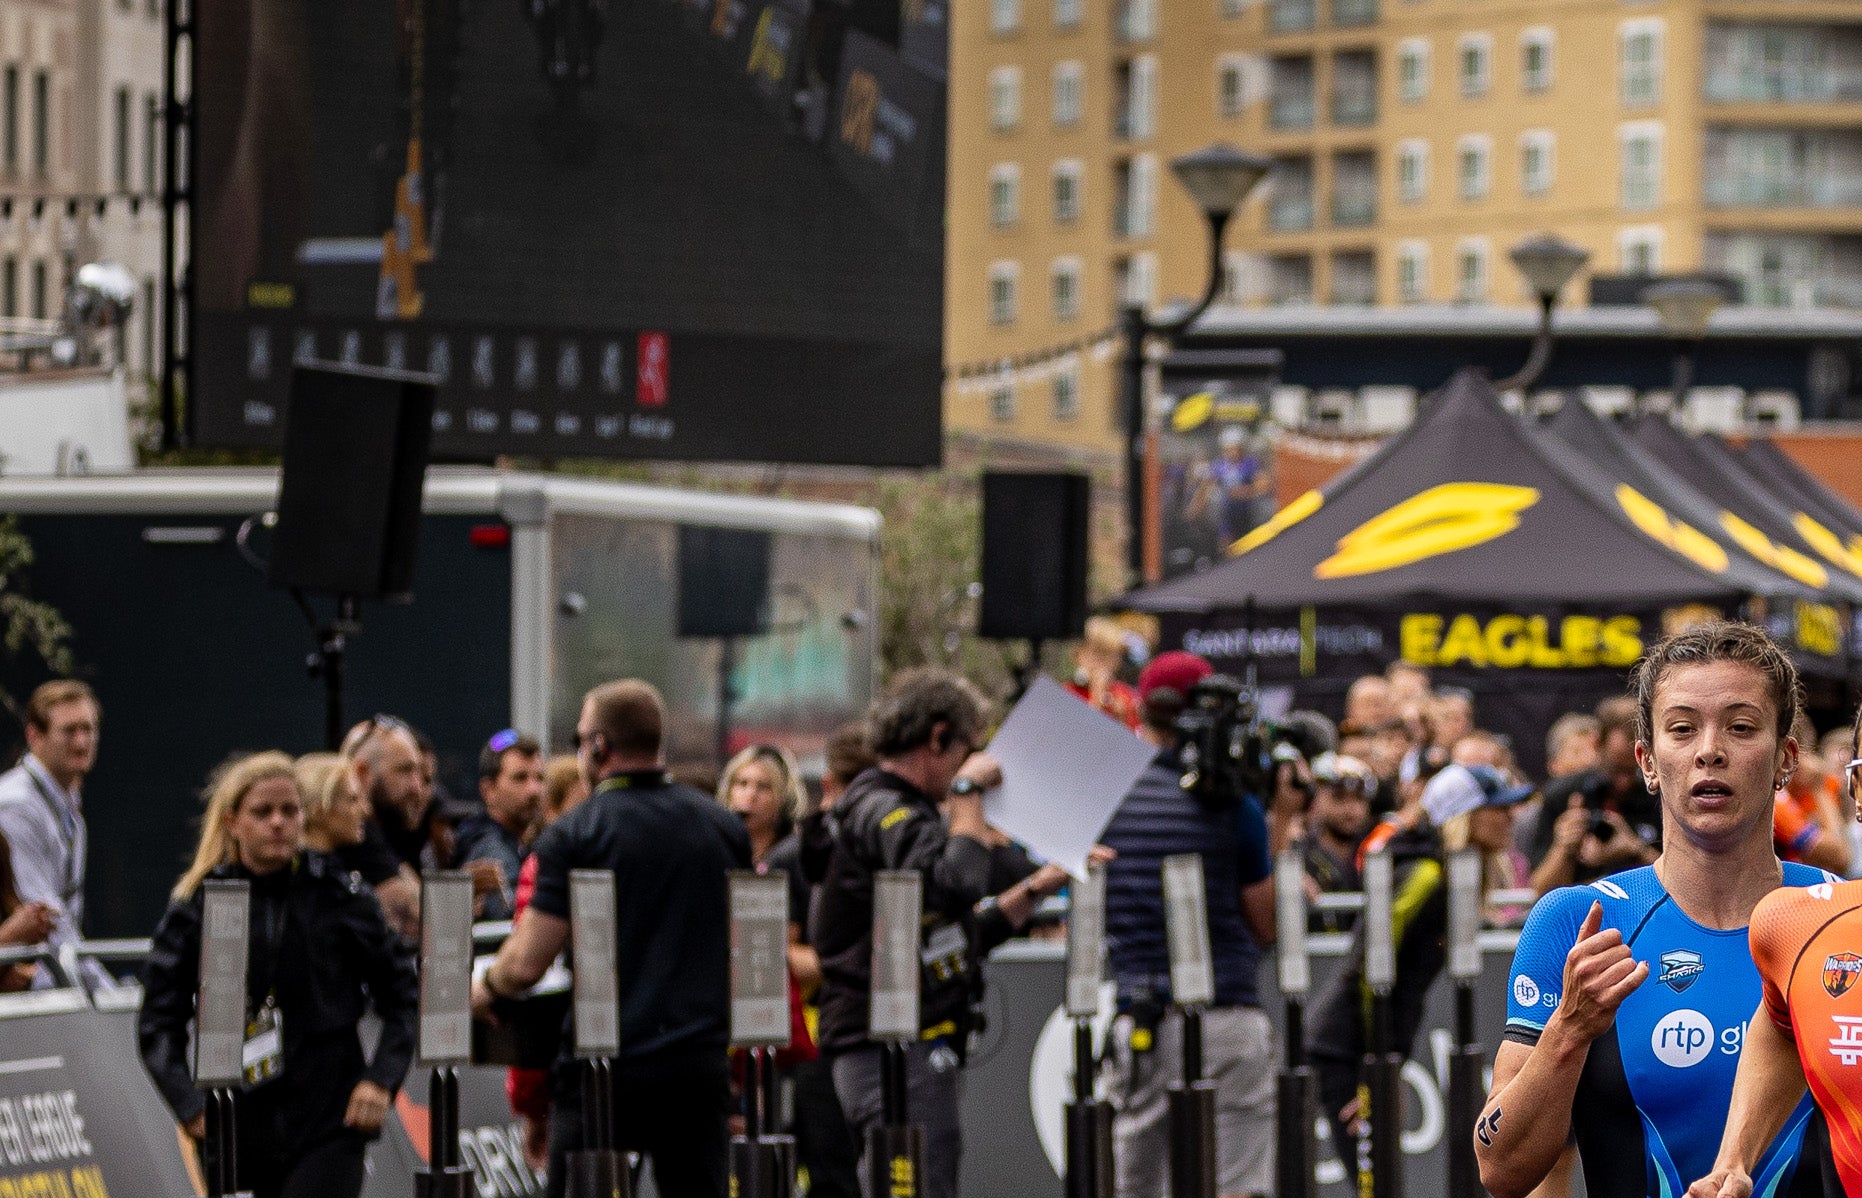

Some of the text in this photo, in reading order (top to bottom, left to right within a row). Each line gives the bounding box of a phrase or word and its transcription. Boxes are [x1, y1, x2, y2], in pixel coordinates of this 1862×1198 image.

[1402, 614, 1644, 668] EAGLES
[1515, 982, 1537, 1001] rtp
[1660, 1021, 1706, 1055] rtp
[13, 1088, 94, 1162] LEAGUE
